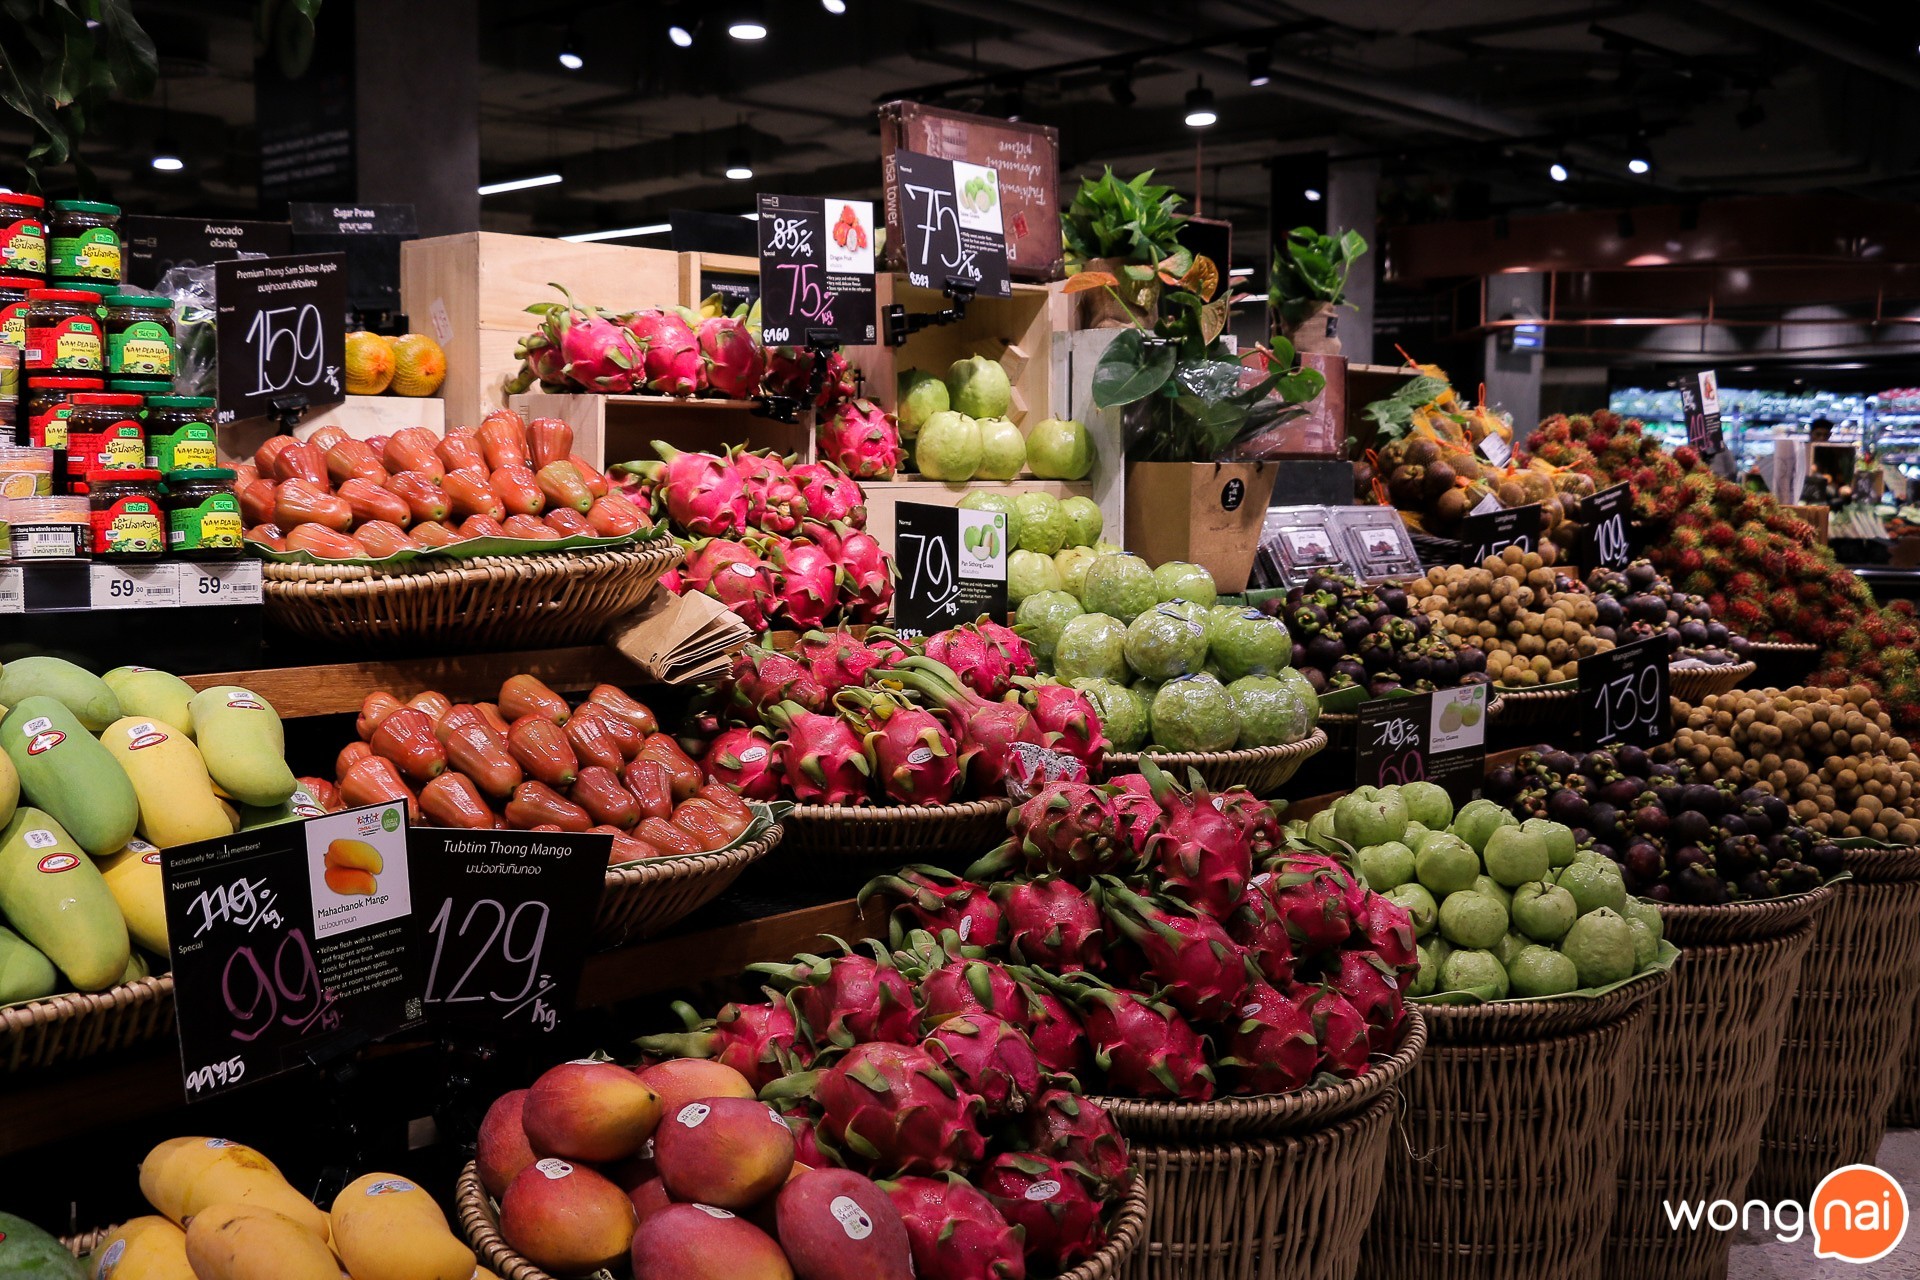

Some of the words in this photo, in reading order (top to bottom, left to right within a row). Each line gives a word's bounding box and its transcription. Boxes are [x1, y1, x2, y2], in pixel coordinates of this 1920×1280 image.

[333, 207, 353, 220] Sugar
[888, 185, 898, 226] tower
[205, 224, 243, 236] Avocado
[773, 218, 799, 250] 85
[904, 183, 961, 268] 75
[237, 269, 265, 279] Premium
[265, 267, 284, 278] Thong
[285, 265, 298, 275] Sam
[305, 264, 319, 273] Rose
[320, 262, 337, 273] Apple
[777, 263, 821, 318] 75
[245, 303, 324, 396] 159
[1594, 513, 1625, 565] 109
[899, 533, 952, 603] 79
[1595, 664, 1660, 743] 139
[170, 855, 205, 868] Exclusively
[205, 852, 215, 860] for
[230, 842, 261, 854] members!
[444, 840, 487, 853] Tubtim
[489, 841, 528, 857] Thong
[530, 843, 572, 859] Mango
[466, 862, 542, 875] มะม่วงทับทิมทอง
[172, 877, 201, 891] Normal
[317, 899, 364, 919] Mahachanok
[365, 894, 389, 906] Mango
[178, 941, 204, 955] Special
[320, 945, 339, 955] Yellow
[340, 941, 353, 949] flesh
[354, 937, 366, 945] with
[372, 932, 388, 940] sweet
[389, 927, 402, 936] taste
[424, 897, 550, 1003] 129
[323, 964, 338, 974] Look
[339, 961, 347, 969] for
[348, 958, 360, 966] firm
[361, 955, 373, 963] fruit
[374, 949, 395, 959] without
[333, 950, 355, 961] fragrant
[222, 928, 321, 1042] 99
[323, 974, 341, 984] mushy
[342, 970, 353, 978] and
[354, 964, 372, 974] brown
[325, 984, 341, 992] Store
[348, 977, 364, 985] room
[339, 990, 352, 998] fruit
[352, 987, 363, 995] can
[186, 1054, 245, 1093] 9975
[837, 1203, 854, 1214] Ruby
[840, 1207, 861, 1222] Mango
